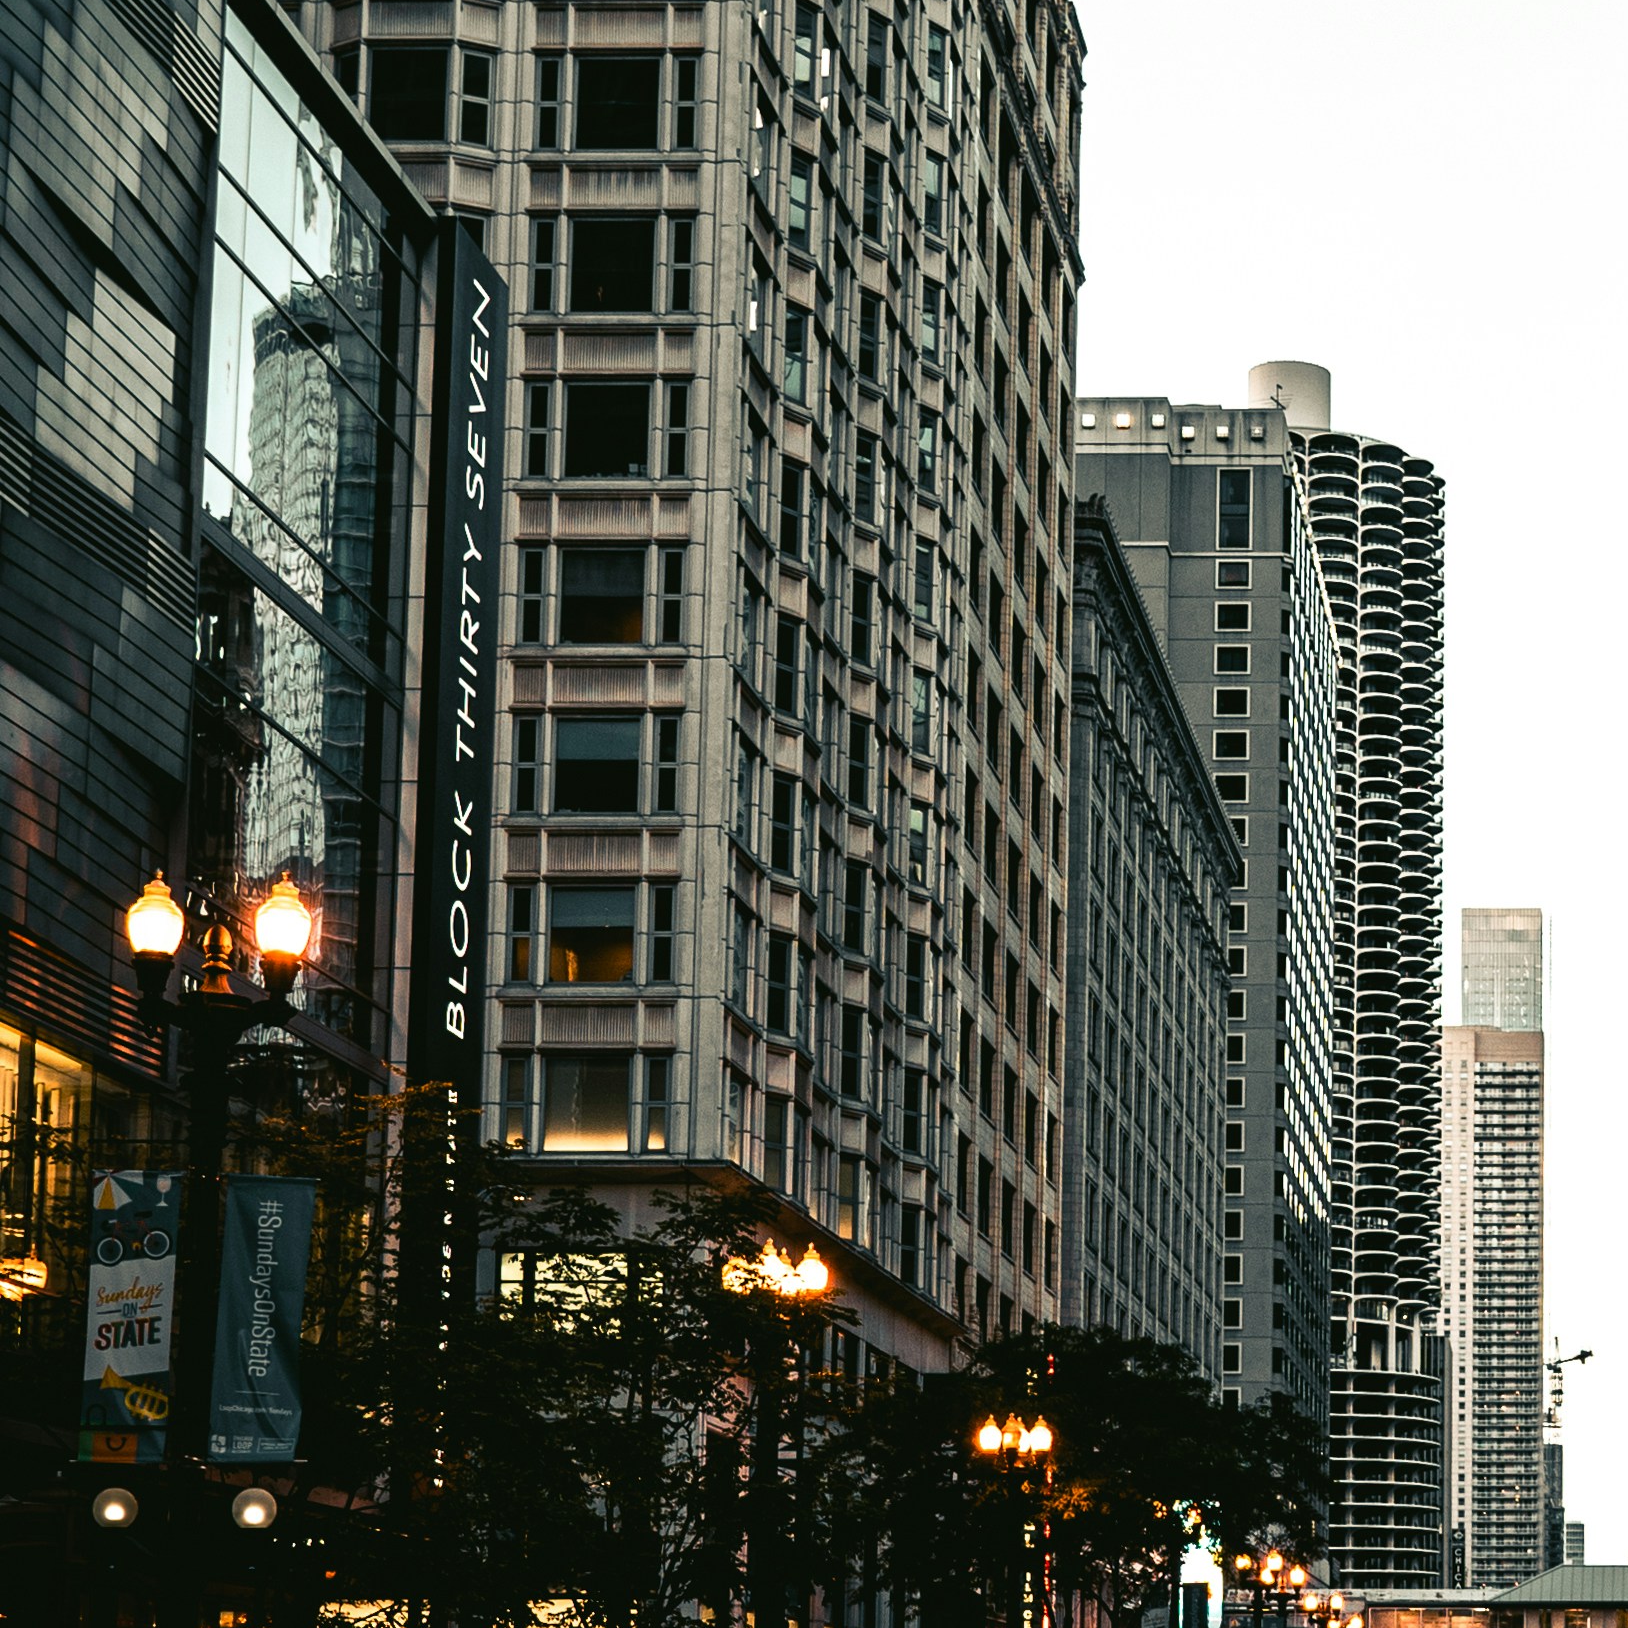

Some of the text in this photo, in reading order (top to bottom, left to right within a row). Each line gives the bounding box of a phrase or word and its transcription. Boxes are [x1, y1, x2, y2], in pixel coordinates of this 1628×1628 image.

[447, 278, 492, 1040] BLOCK THIRTY SEVEN
[96, 1276, 164, 1313] Sundays
[248, 1199, 284, 1378] #SundaysOnState
[123, 1302, 138, 1318] ON
[94, 1316, 162, 1351] STATE
[232, 1441, 253, 1450] LOOP
